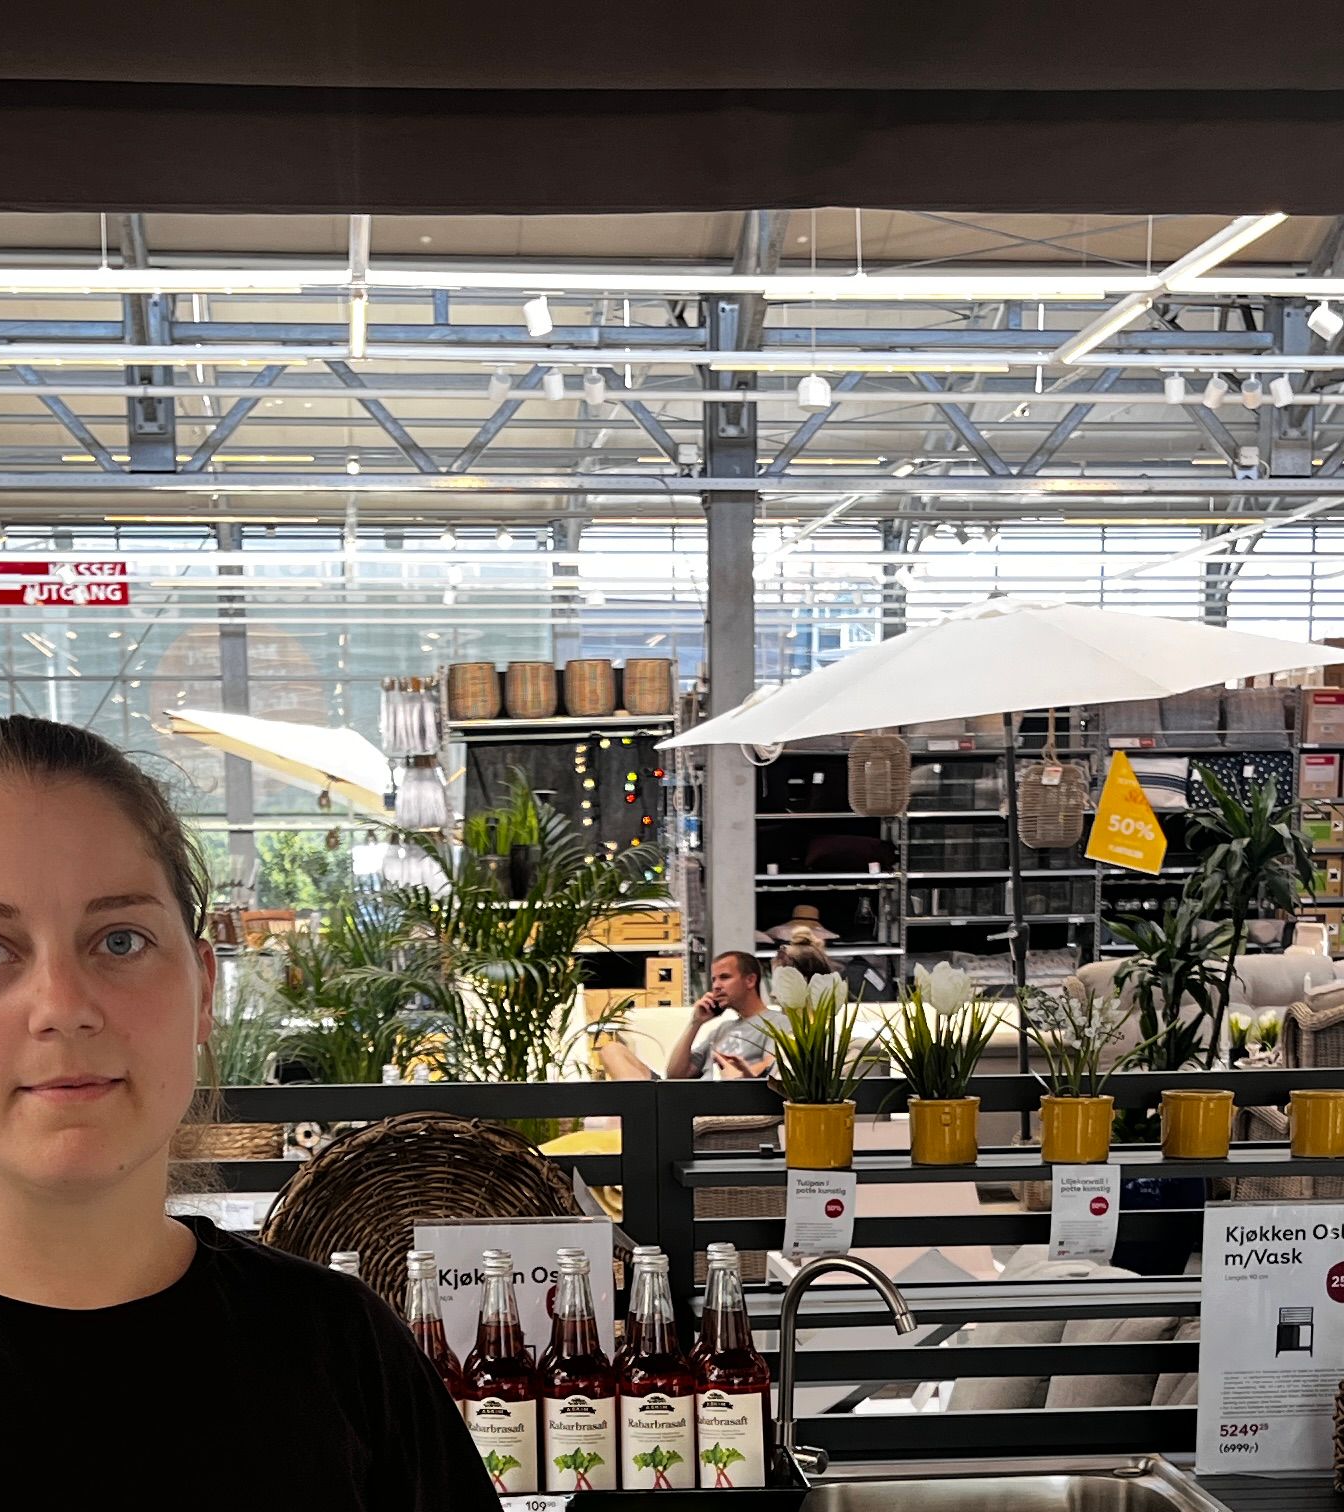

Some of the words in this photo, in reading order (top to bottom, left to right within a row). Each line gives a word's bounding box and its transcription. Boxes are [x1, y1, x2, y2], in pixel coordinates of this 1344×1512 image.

[1108, 814, 1155, 841] 50%
[1226, 1225, 1307, 1247] Kjøkken
[1224, 1247, 1304, 1270] m/Vask
[438, 1267, 525, 1291] Kjøkn
